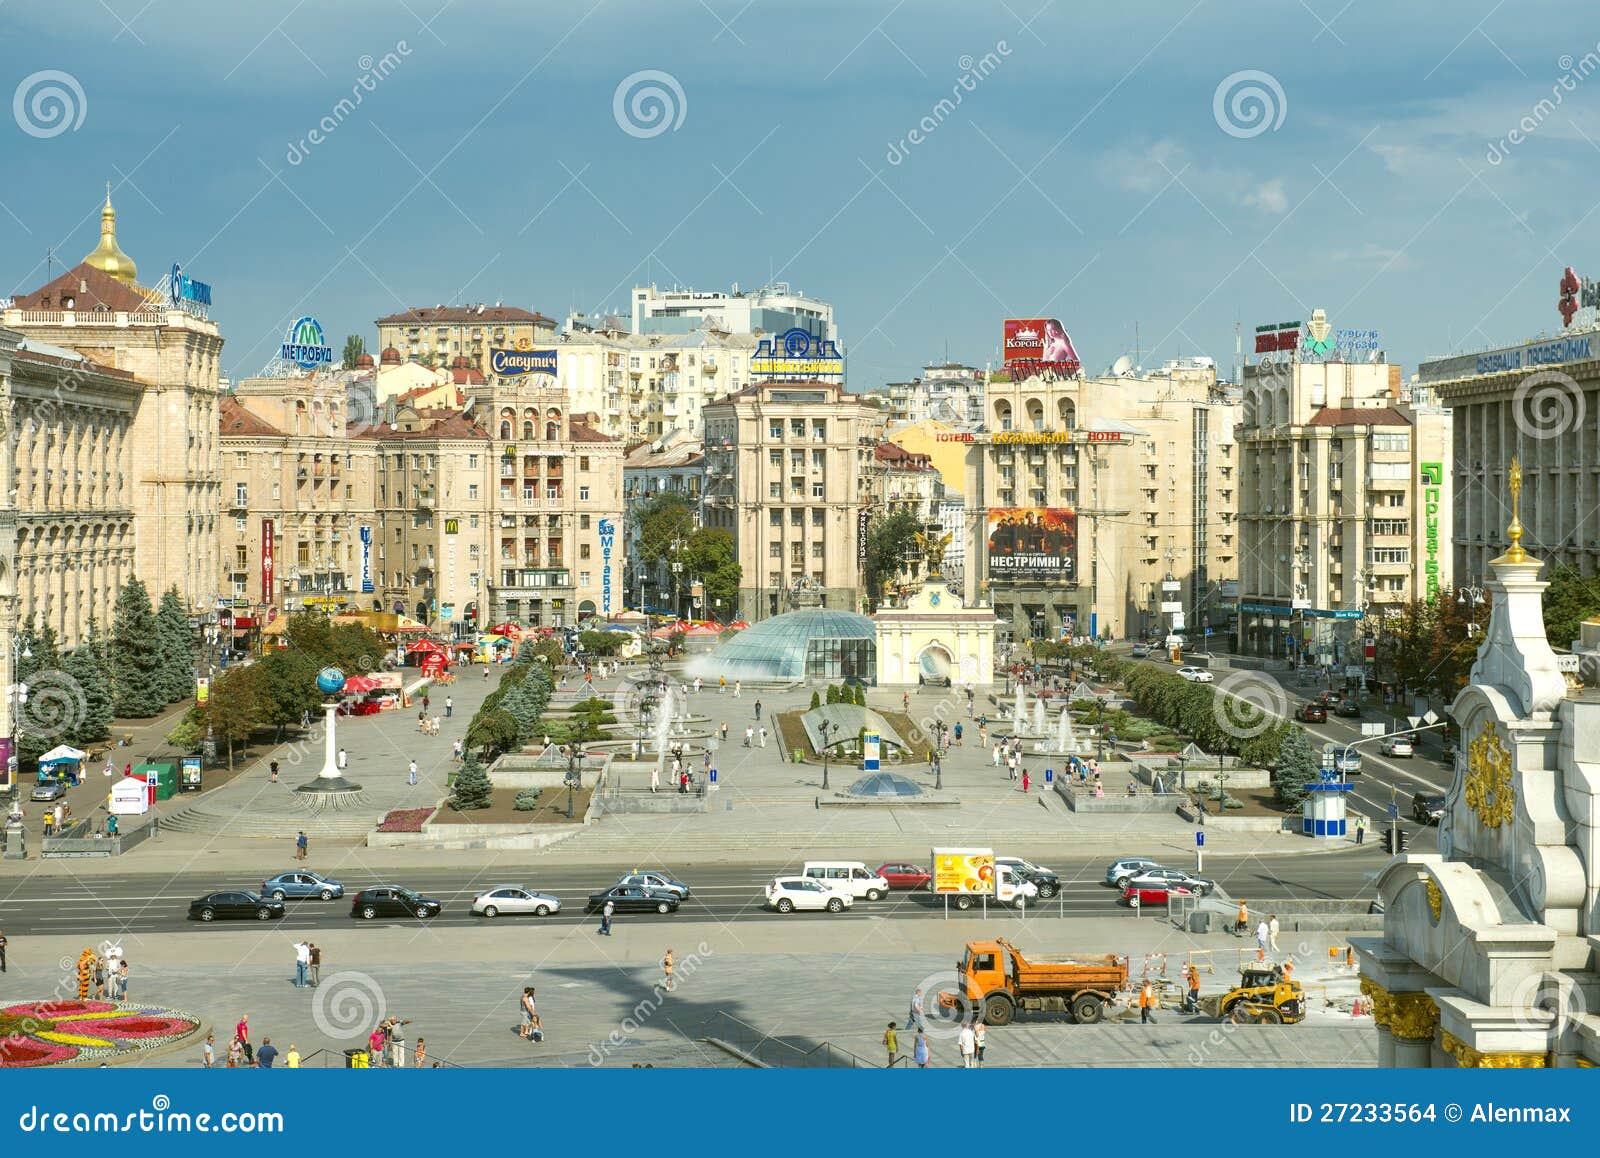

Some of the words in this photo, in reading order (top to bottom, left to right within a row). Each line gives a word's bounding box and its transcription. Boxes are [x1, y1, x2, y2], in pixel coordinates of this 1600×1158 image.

[282, 344, 332, 362] МЕТРОБУД
[492, 351, 556, 373] Славутич
[936, 434, 975, 442] ГОТЕЛЬ
[990, 556, 1060, 567] НЕСТРИМНІ
[1063, 557, 1072, 567] 2
